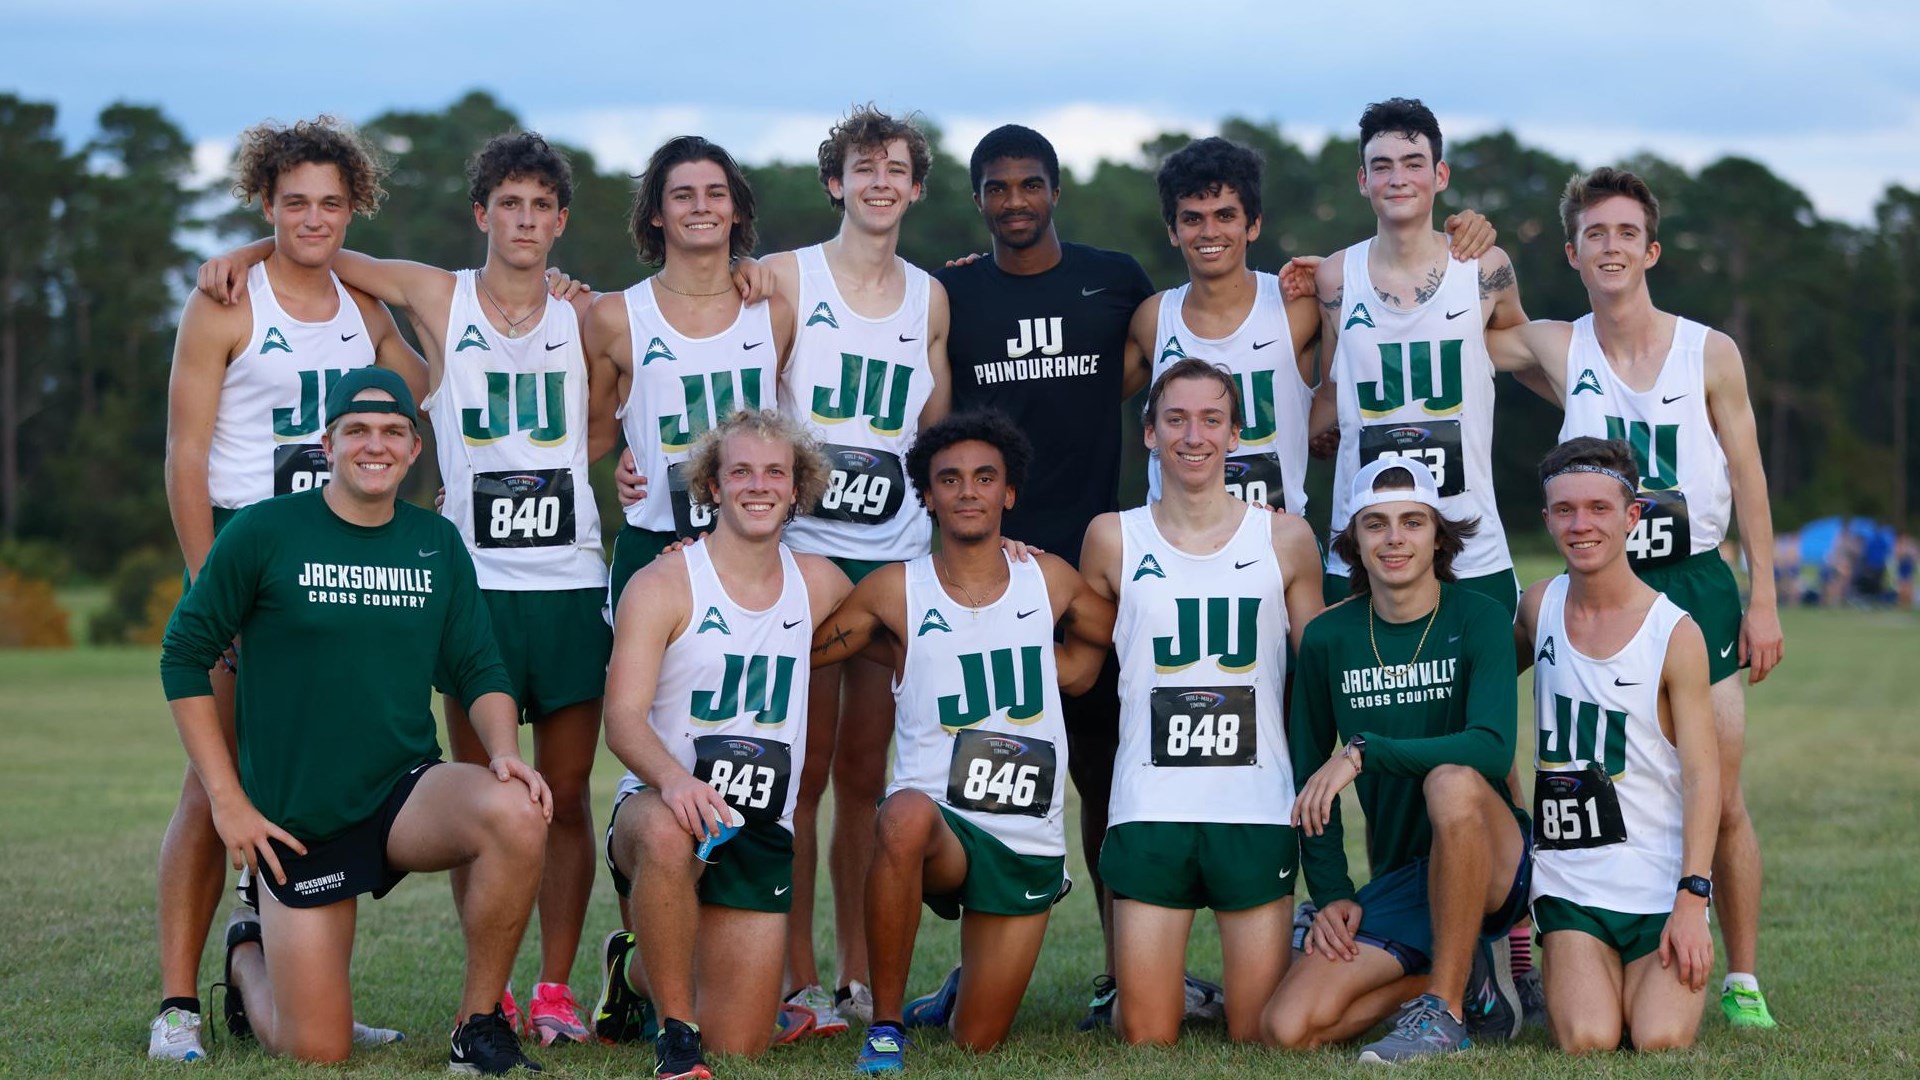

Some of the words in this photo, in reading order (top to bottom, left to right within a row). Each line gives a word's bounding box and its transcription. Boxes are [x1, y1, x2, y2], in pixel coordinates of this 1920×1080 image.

[1006, 317, 1062, 358] JU
[974, 355, 1100, 385] PHINDURANCE
[1356, 339, 1464, 418] JU
[272, 368, 342, 442] J
[462, 371, 567, 448] JU
[811, 352, 914, 437] JU
[1231, 369, 1276, 446] U
[822, 469, 891, 516] 849
[490, 496, 560, 538] 840
[1625, 516, 1674, 560] 45
[299, 563, 433, 593] JACKSONVILLE
[308, 590, 357, 604] CROSS
[363, 593, 426, 608] COUNTRY
[1152, 597, 1263, 674] JU
[690, 653, 797, 729] JU
[938, 646, 1044, 735] JU
[1350, 694, 1391, 709] CROSS
[1167, 713, 1240, 757] 848
[1539, 693, 1629, 783] JU
[708, 759, 776, 809] 843
[963, 758, 1040, 807] 846
[1542, 796, 1602, 840] 851
[294, 871, 346, 892] JACKSONVILLE
[301, 888, 319, 896] TRACK
[326, 882, 342, 890] FIELD
